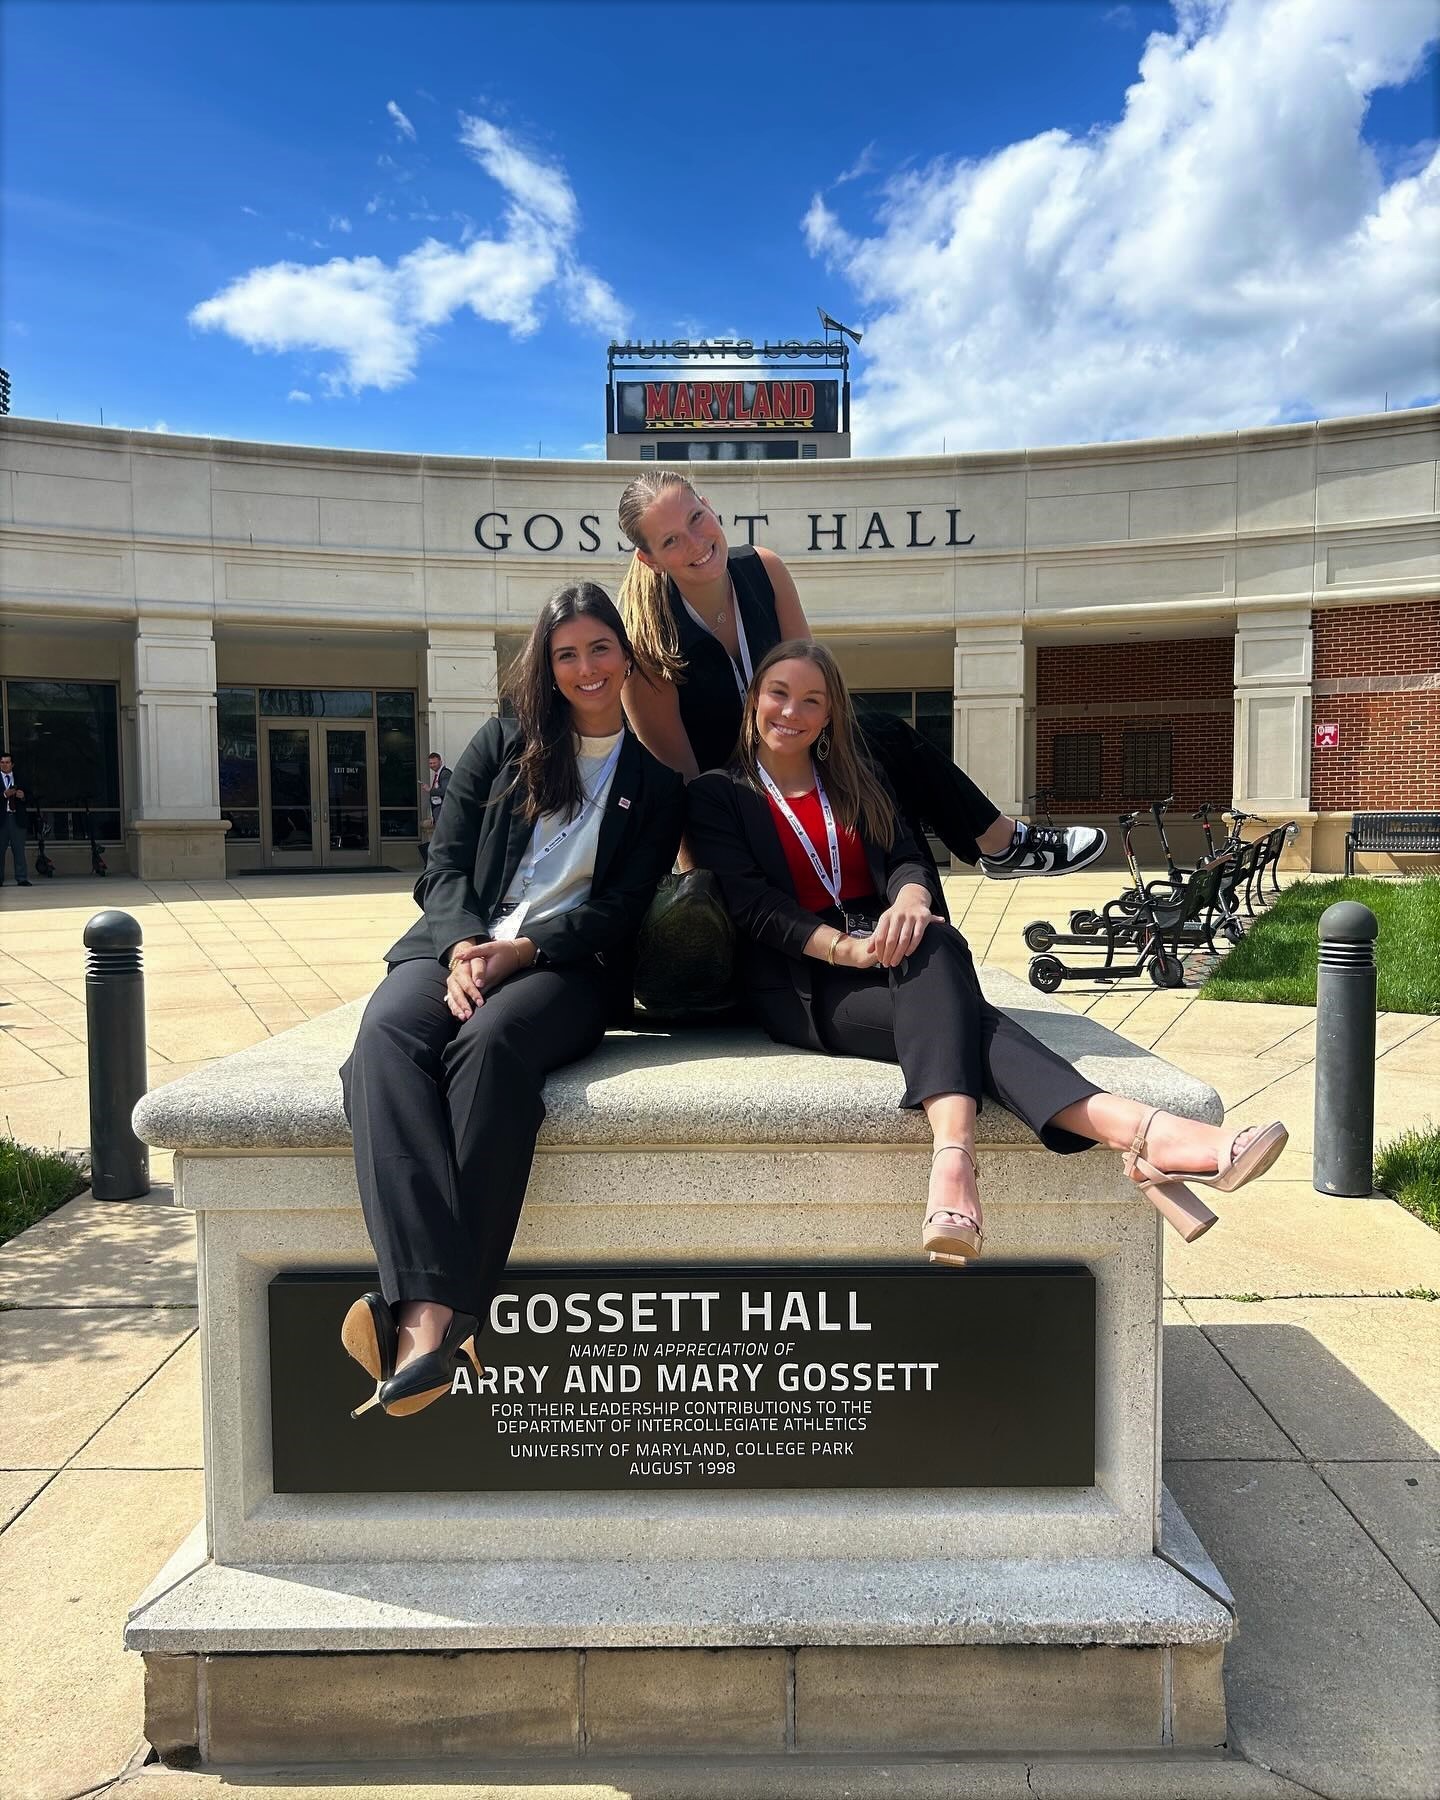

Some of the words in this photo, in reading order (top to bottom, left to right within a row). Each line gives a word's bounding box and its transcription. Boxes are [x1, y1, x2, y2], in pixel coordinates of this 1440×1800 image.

[645, 382, 815, 420] MARYLAND
[474, 512, 769, 552] GOST
[807, 509, 976, 551] HALL
[489, 1292, 720, 1334] GOSSETT
[741, 1291, 872, 1332] HALL
[569, 1343, 628, 1358] NAMED
[632, 1343, 650, 1357] IN
[653, 1342, 769, 1357] APPRECIATION
[773, 1342, 796, 1356] OF
[450, 1365, 550, 1395] ARRY
[563, 1364, 641, 1394] AND
[657, 1363, 764, 1393] MARY
[778, 1362, 940, 1392] GOSSETT
[491, 1403, 523, 1417] FOR
[527, 1402, 575, 1417] THEIR
[580, 1401, 680, 1416] LEADERSHIP
[684, 1400, 812, 1415] CONTRIBUTIONS
[815, 1400, 837, 1414] TO
[840, 1400, 872, 1414] THE
[497, 1419, 607, 1434] DEPARTMENT
[610, 1418, 632, 1433] OF
[637, 1417, 779, 1433] INTERCOLLEGIATE
[783, 1417, 867, 1431] ATHLETICS
[510, 1443, 604, 1458] UNIVERSITY
[609, 1443, 631, 1457] OF
[636, 1442, 730, 1458] MARYLAND,
[735, 1442, 806, 1456] COLLEGE
[811, 1441, 854, 1456] PARK
[629, 1461, 693, 1476] AUGUST
[697, 1461, 736, 1475] 1998
